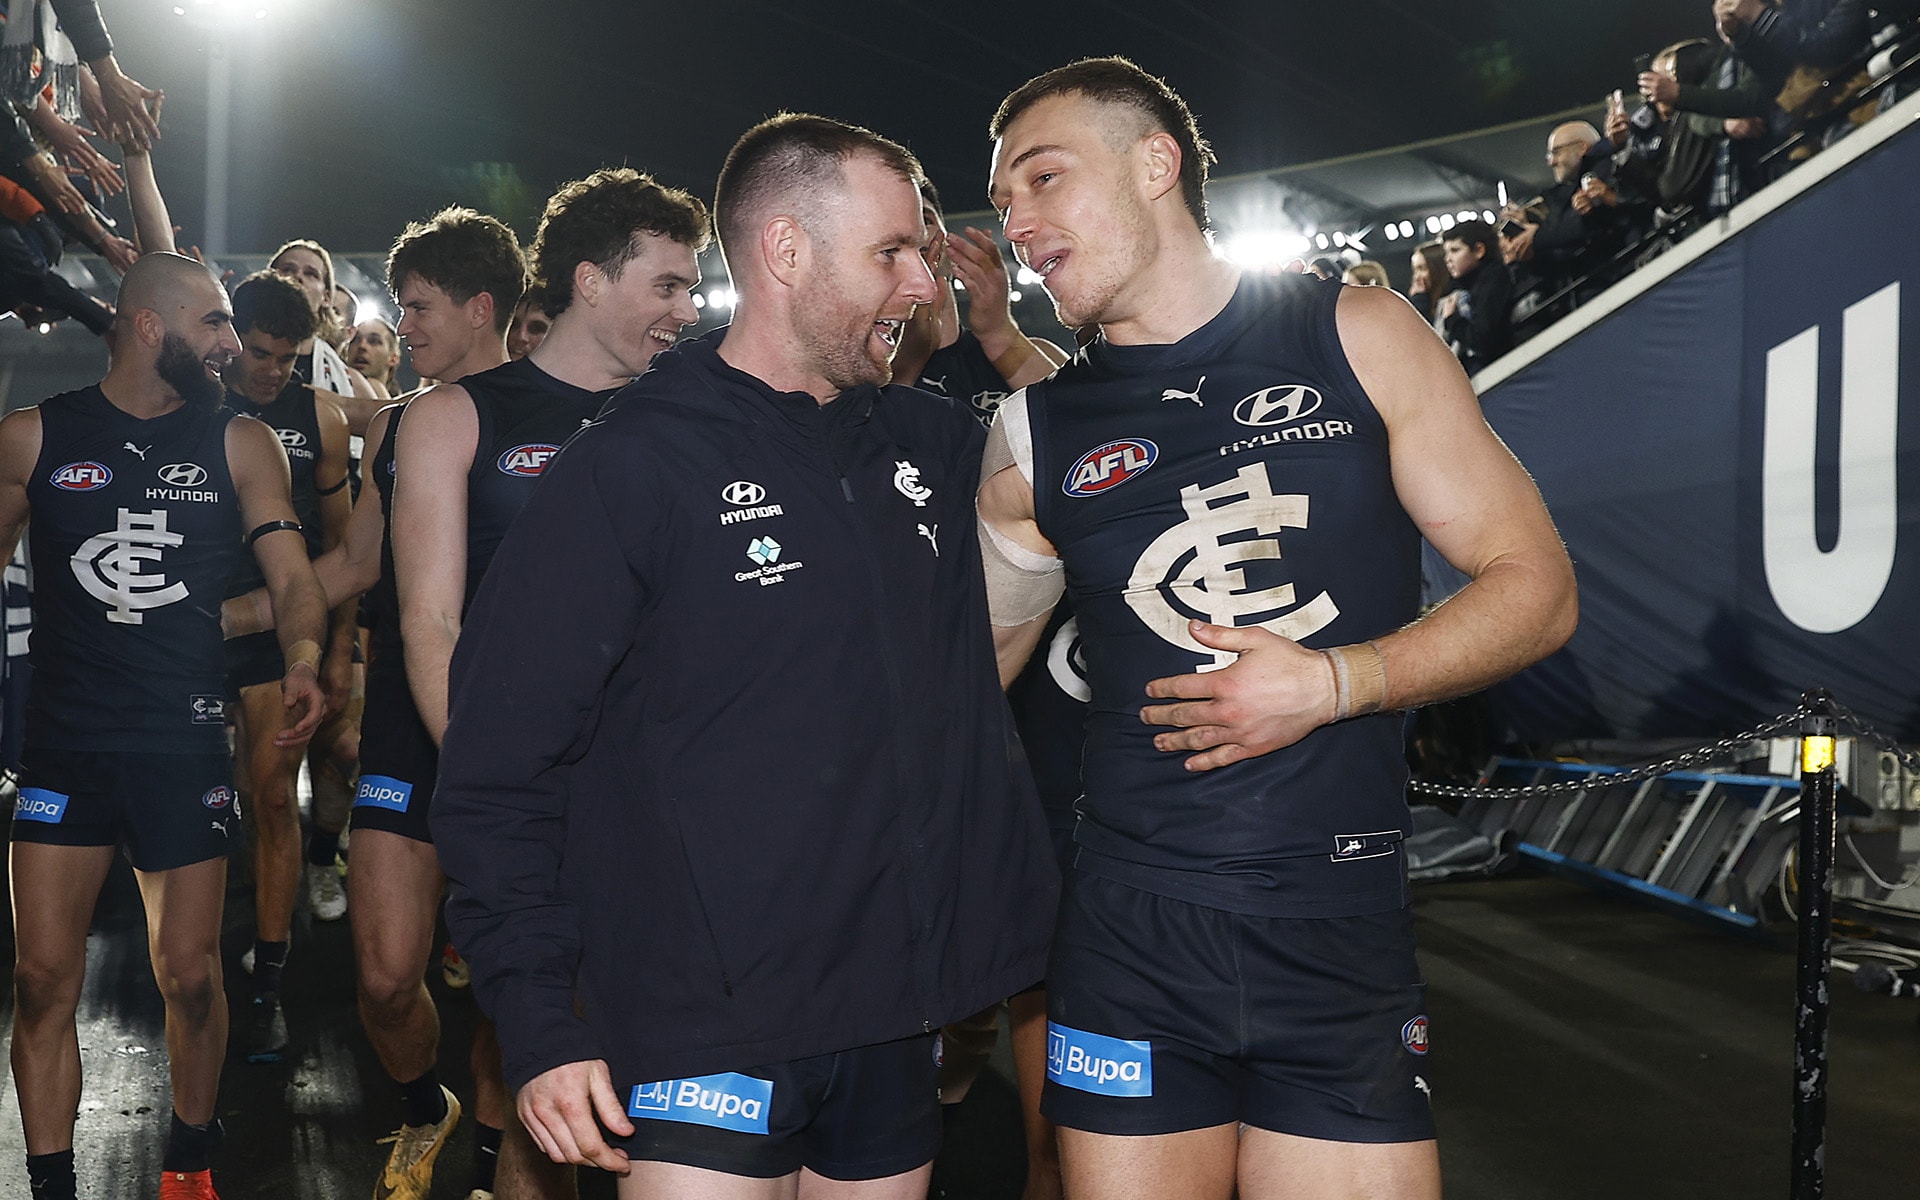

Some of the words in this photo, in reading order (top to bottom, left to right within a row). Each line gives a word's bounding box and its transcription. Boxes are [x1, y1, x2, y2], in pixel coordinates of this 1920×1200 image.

[1220, 420, 1353, 456] HYUNDAI
[505, 451, 558, 470] AF
[1763, 281, 1900, 634] U
[54, 468, 106, 484] AFL
[1070, 446, 1149, 491] AFL
[146, 488, 218, 503] HYUNDAI
[720, 504, 784, 525] HYUNDAI
[735, 569, 763, 581] Great
[762, 561, 803, 575] Southern
[760, 573, 785, 586] Bank
[207, 791, 230, 804] AFL
[360, 783, 405, 803] Bupa
[1066, 1045, 1142, 1084] Bupa
[675, 1081, 762, 1120] Bupa
